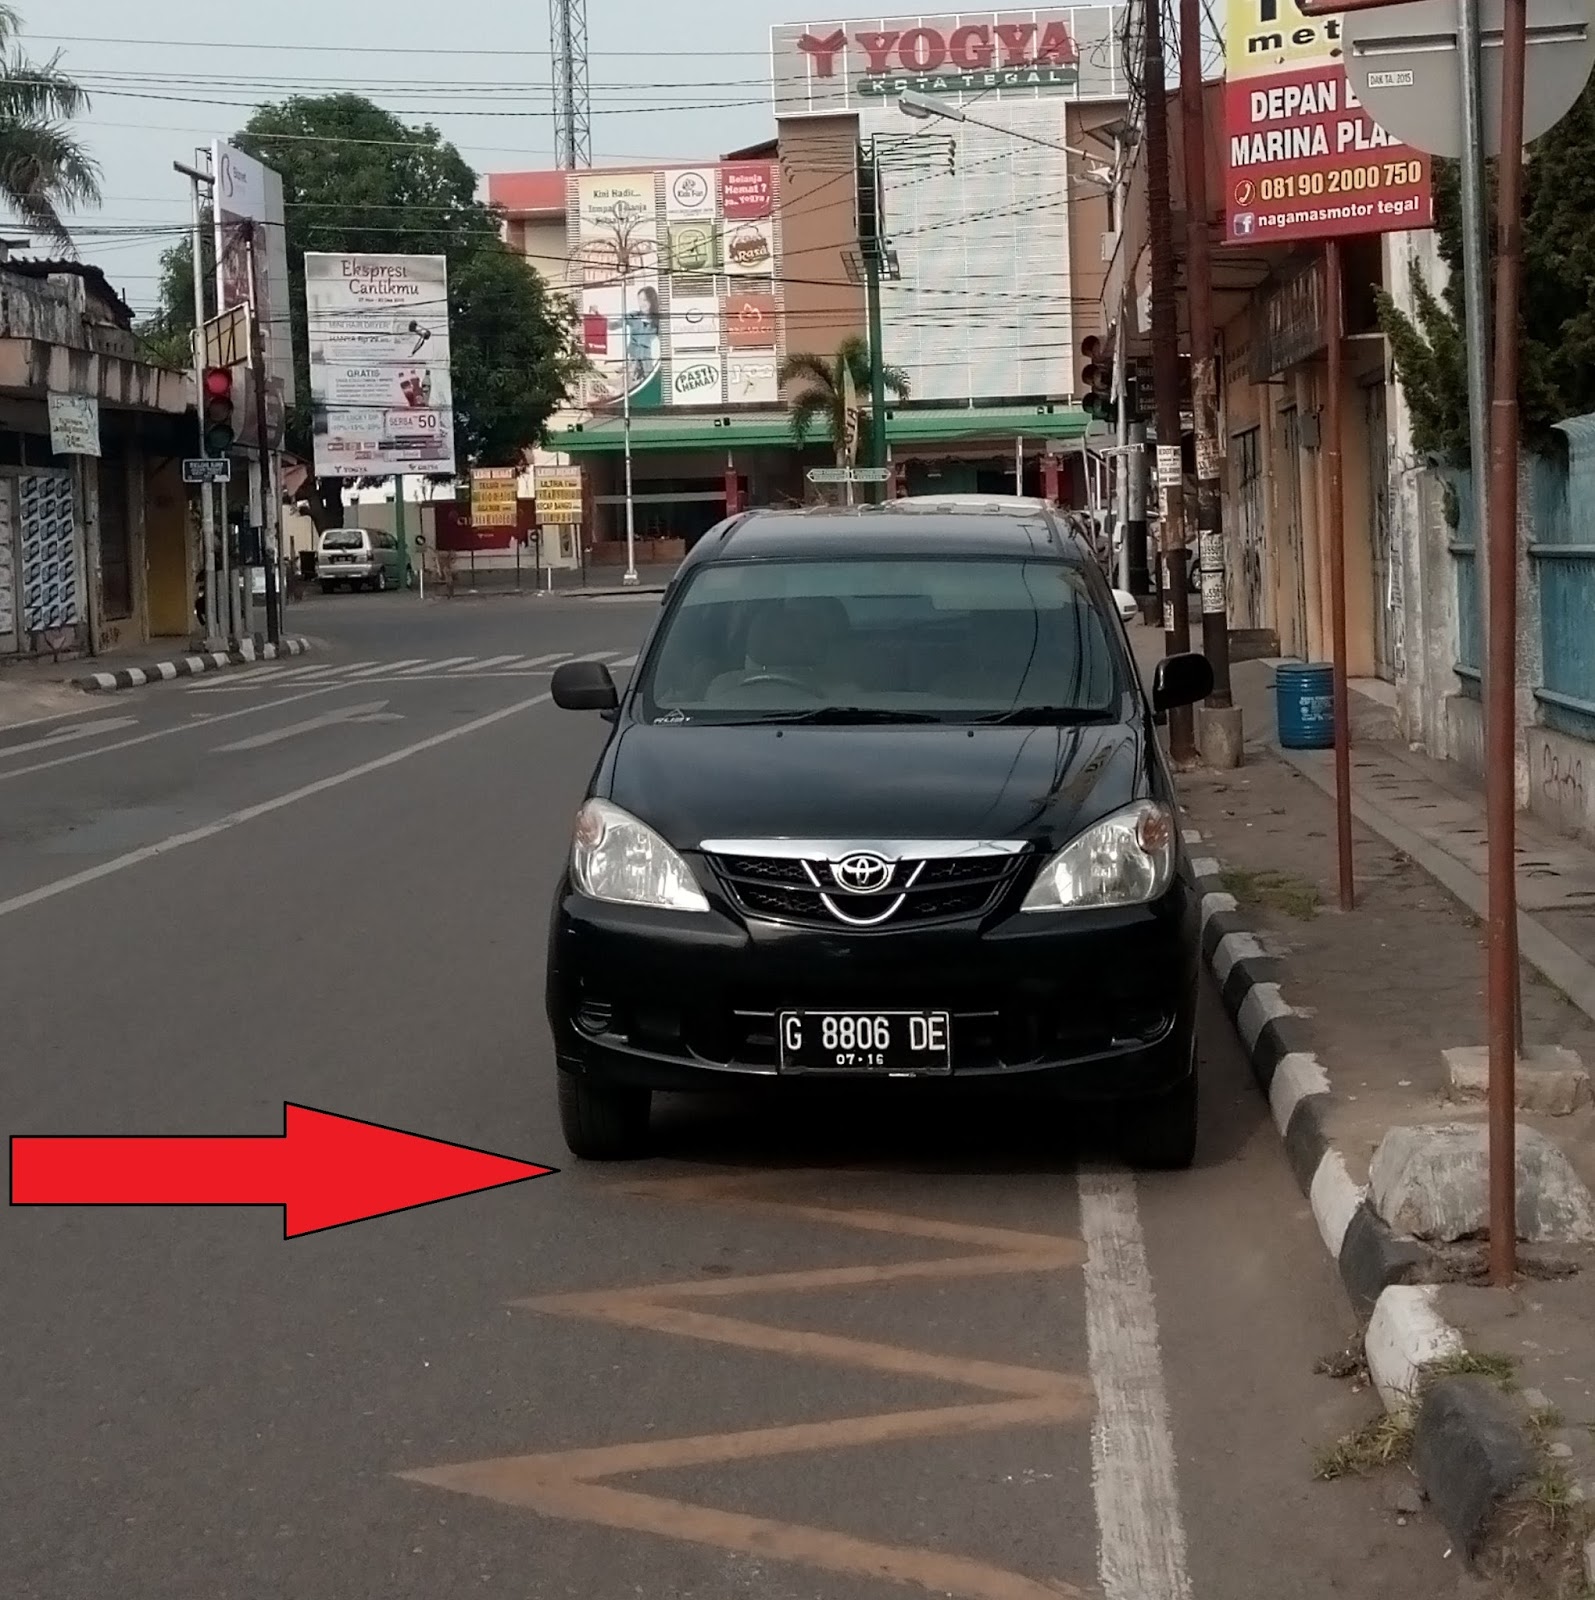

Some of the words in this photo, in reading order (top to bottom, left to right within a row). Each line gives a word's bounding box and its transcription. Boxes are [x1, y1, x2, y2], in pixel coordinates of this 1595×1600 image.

[1248, 20, 1341, 53] met
[855, 21, 1080, 76] YOGYA
[872, 76, 949, 92] KOTA
[962, 71, 1061, 87] TEGAL
[1251, 78, 1337, 123] DEPAN
[1231, 124, 1329, 167] MARINA
[724, 184, 759, 195] Hemat
[729, 173, 763, 185] Belanja
[1261, 176, 1294, 200] 081
[1298, 172, 1325, 197] 90
[1328, 165, 1380, 193] 2000
[1384, 161, 1422, 186] 750
[1258, 205, 1374, 229] nagamasmotor
[1377, 196, 1419, 217] tegal
[341, 258, 407, 282] Ekspresi
[349, 277, 420, 296] Cantikmu
[347, 368, 381, 378] GRATIS
[680, 366, 712, 384] PASTI
[682, 373, 715, 392] HEMAT
[418, 414, 437, 429] 50
[785, 1016, 802, 1050] G
[821, 1016, 890, 1050] 8806
[908, 1017, 946, 1050] DE
